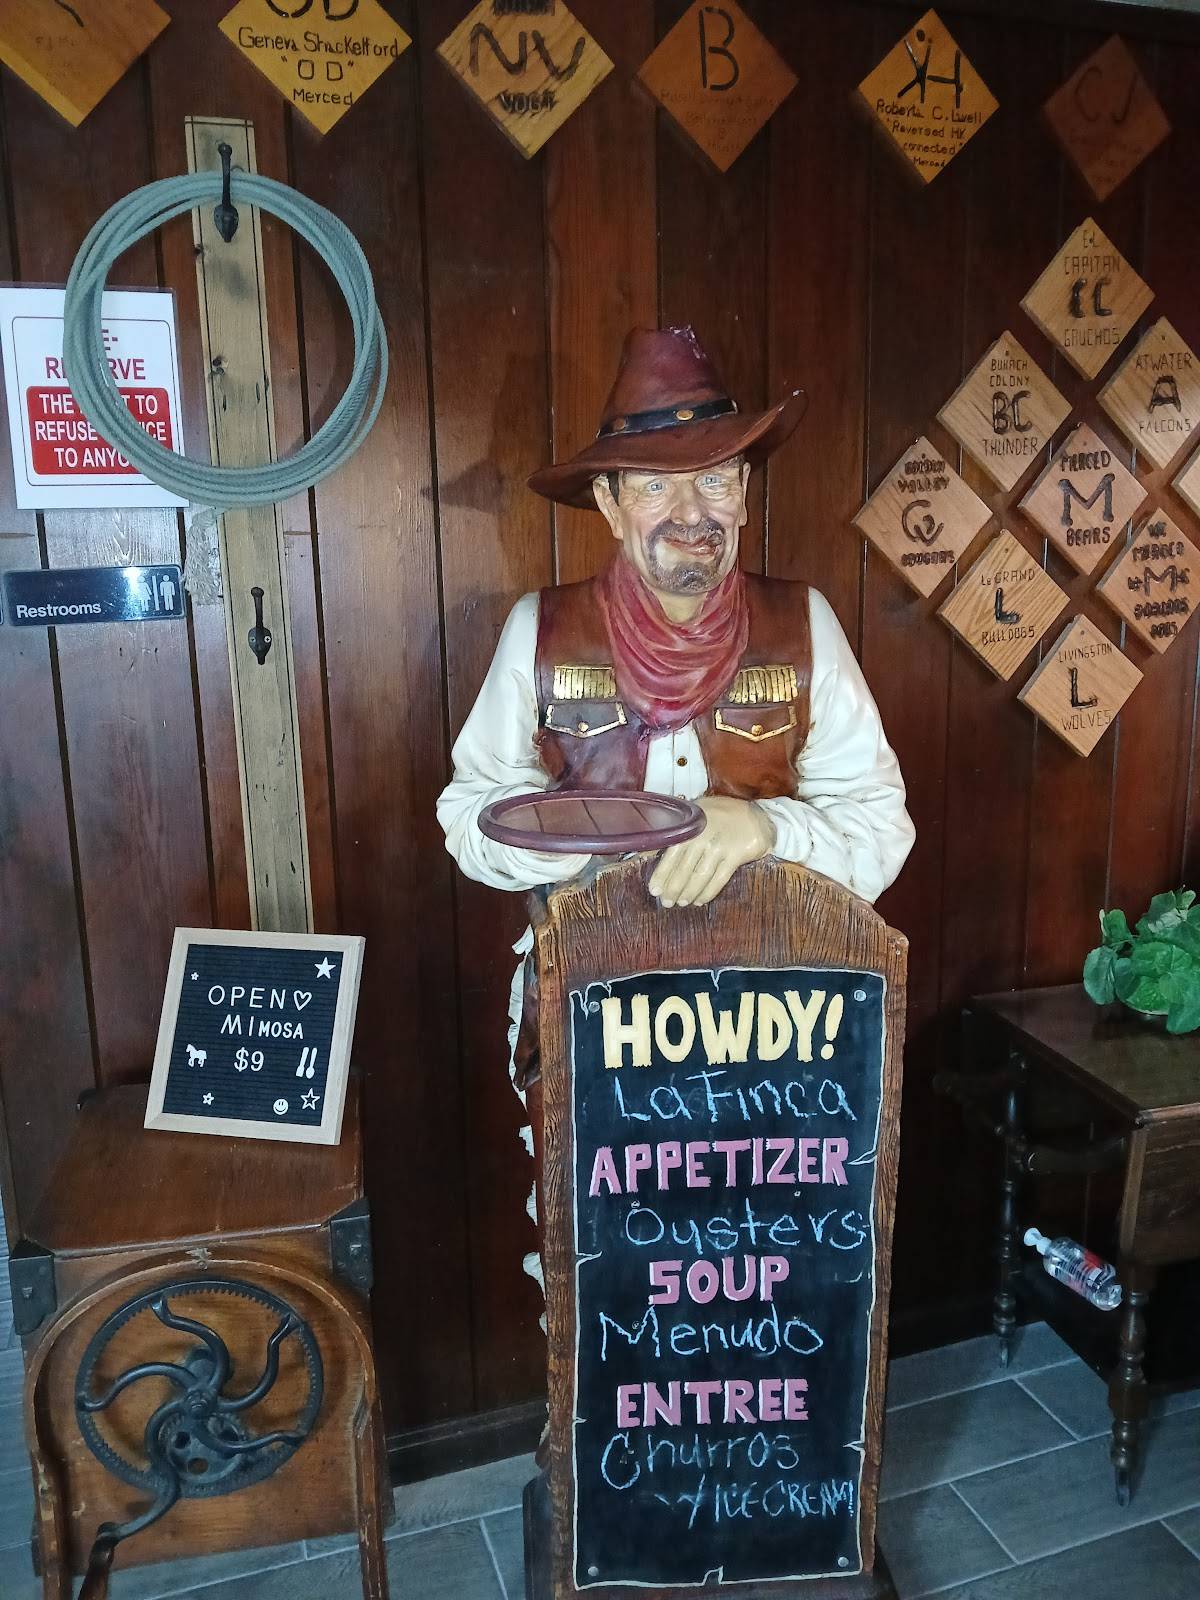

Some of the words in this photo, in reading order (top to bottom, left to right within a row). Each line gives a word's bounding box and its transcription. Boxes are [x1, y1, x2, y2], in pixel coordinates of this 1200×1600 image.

[292, 88, 354, 106] Merced
[1064, 255, 1121, 276] CAPITAN
[1064, 327, 1121, 347] GAUCHOS
[1135, 352, 1193, 371] ATWATER
[990, 375, 1031, 387] COLONY
[39, 393, 75, 415] THE
[135, 394, 158, 415] TO
[1147, 375, 1182, 414] A
[992, 390, 1033, 435] BC
[34, 420, 98, 441] REFUSE
[1138, 418, 1191, 433] FALCONS
[54, 447, 78, 468] TO
[982, 437, 1038, 457] THUNDER
[1061, 450, 1112, 472] MERCED
[1058, 473, 1116, 527] M
[1066, 526, 1111, 547] BEARS
[994, 568, 1036, 584] GRAND
[16, 602, 102, 619] Restrooms
[995, 587, 1021, 625] L
[981, 625, 1036, 646] BULLDOGS
[1058, 643, 1113, 663] LIVINGSTON
[1067, 667, 1098, 708] L
[1061, 709, 1112, 731] WOLVES
[208, 985, 286, 1009] OPEN
[220, 1014, 304, 1040] MIMOSA
[601, 989, 844, 1068] HOWDY!
[233, 1047, 265, 1072] $9
[589, 1138, 849, 1198] APPETIZER
[625, 1197, 869, 1255] Oysters
[648, 1255, 790, 1305] SOUP
[599, 1303, 824, 1361] Menudo
[617, 1378, 809, 1429] ENTREE
[601, 1432, 799, 1490] Churros
